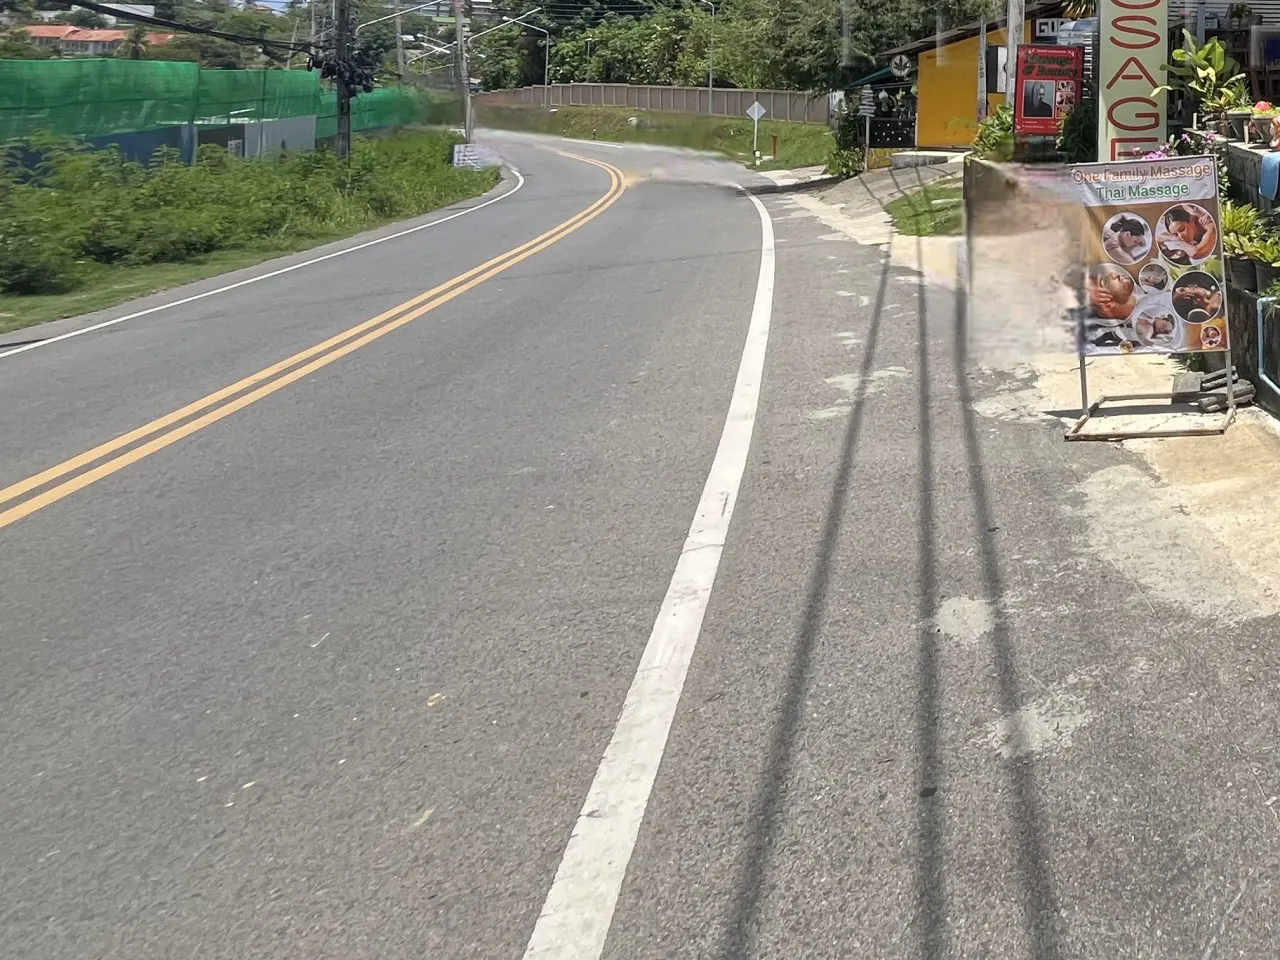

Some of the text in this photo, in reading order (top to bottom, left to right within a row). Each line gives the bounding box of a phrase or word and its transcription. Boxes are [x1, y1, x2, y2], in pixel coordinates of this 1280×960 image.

[1150, 163, 1212, 181] Massage
[1097, 183, 1190, 200] Thai Massage
